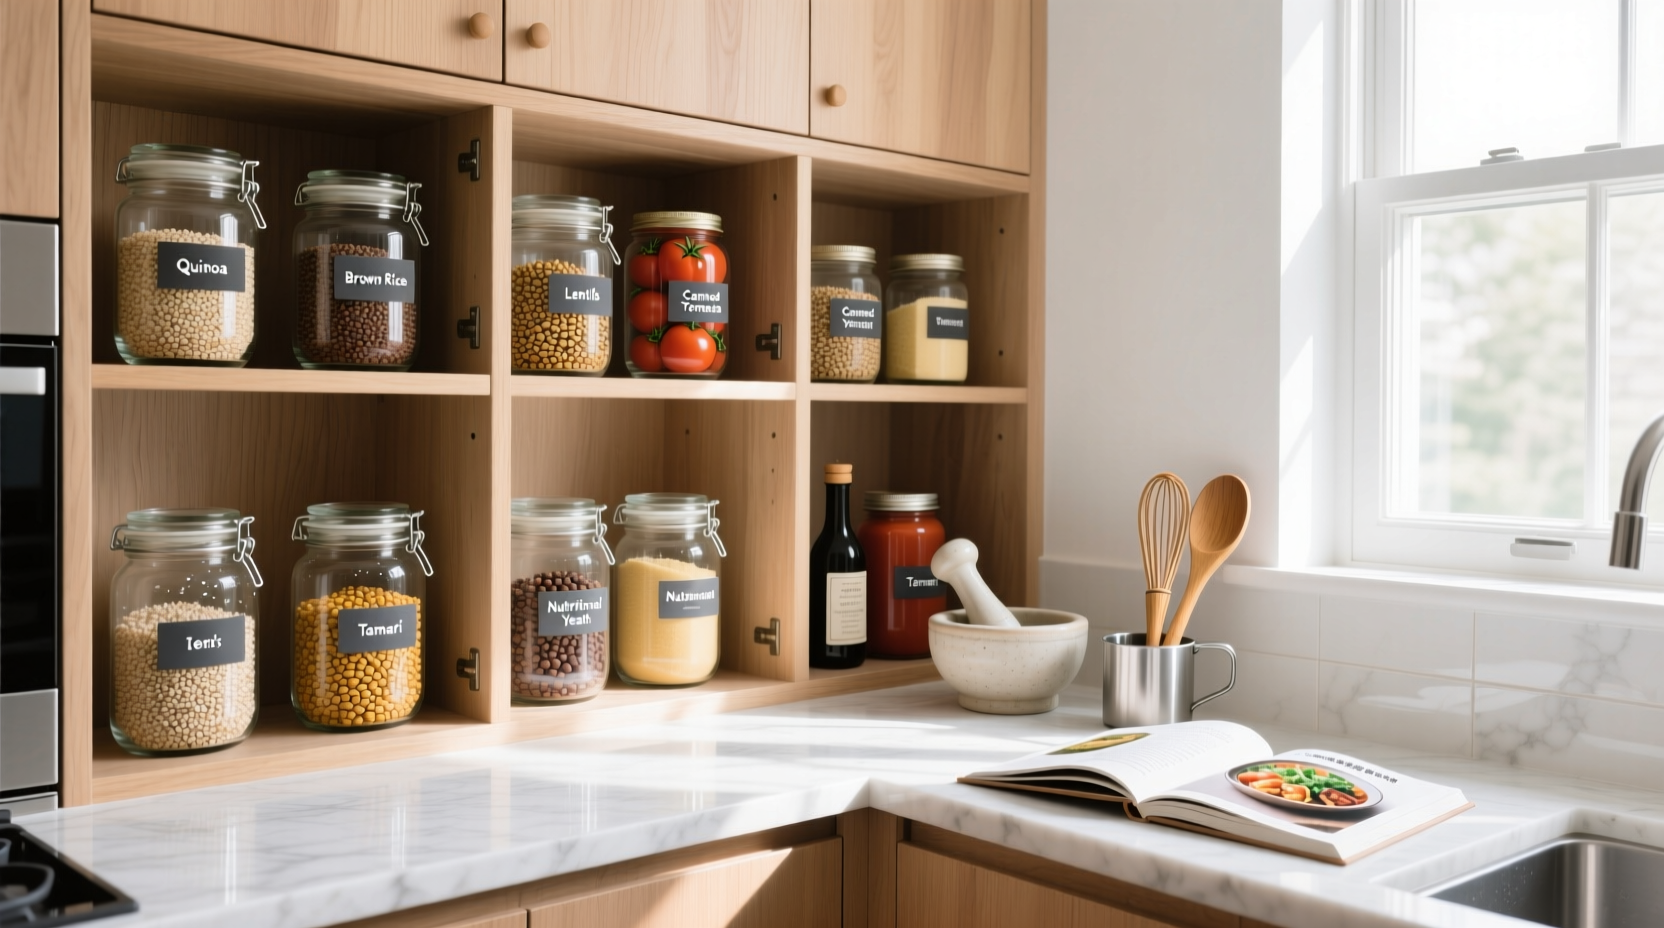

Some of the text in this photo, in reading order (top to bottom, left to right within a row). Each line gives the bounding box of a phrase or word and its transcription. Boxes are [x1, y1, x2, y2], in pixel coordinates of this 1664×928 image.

[176, 257, 228, 278] Quinoa
[345, 270, 408, 287] Brown Rice
[357, 618, 403, 637] Tamari
